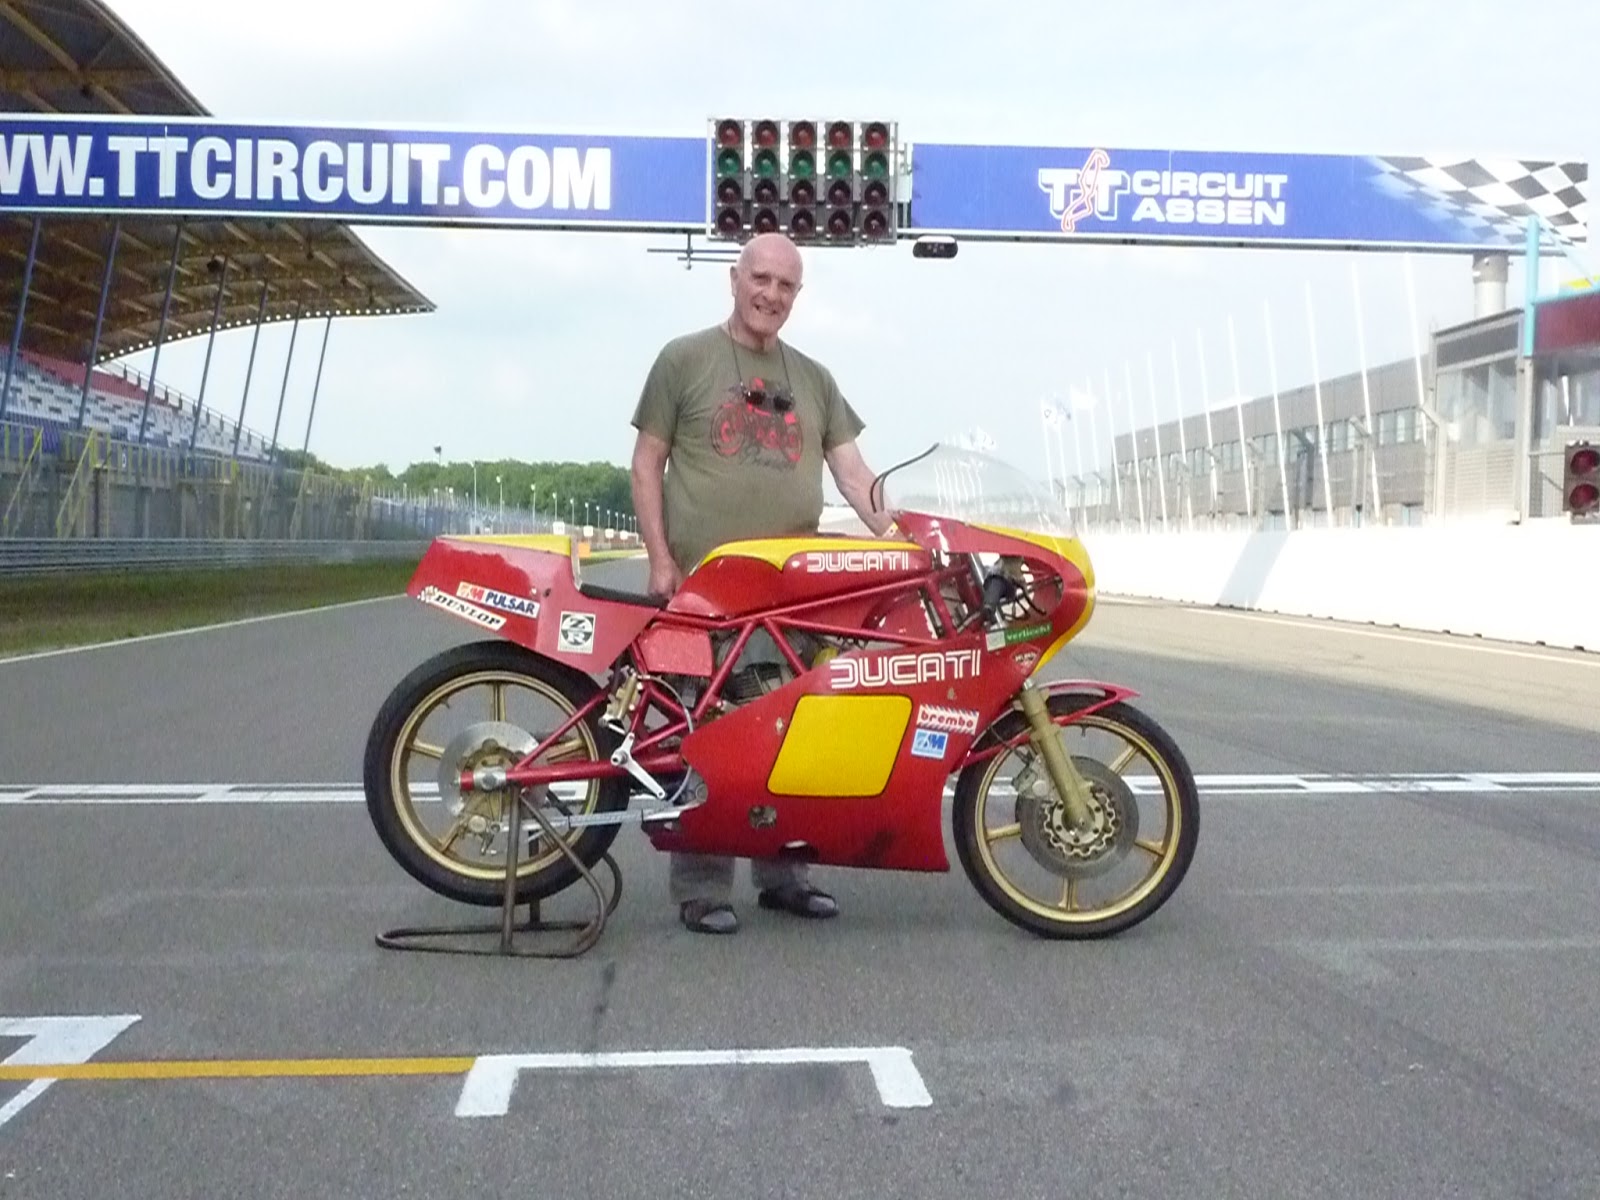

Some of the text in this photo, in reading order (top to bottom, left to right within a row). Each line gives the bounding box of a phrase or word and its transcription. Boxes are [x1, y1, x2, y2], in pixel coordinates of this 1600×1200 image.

[1132, 169, 1288, 199] CIRCUIT
[1132, 197, 1286, 226] ASSEN
[806, 551, 909, 573] DUCATI
[435, 594, 502, 626] DUNLOP
[485, 591, 536, 616] PULSAR
[830, 649, 982, 690] DUCATI
[920, 710, 974, 729] brembo
